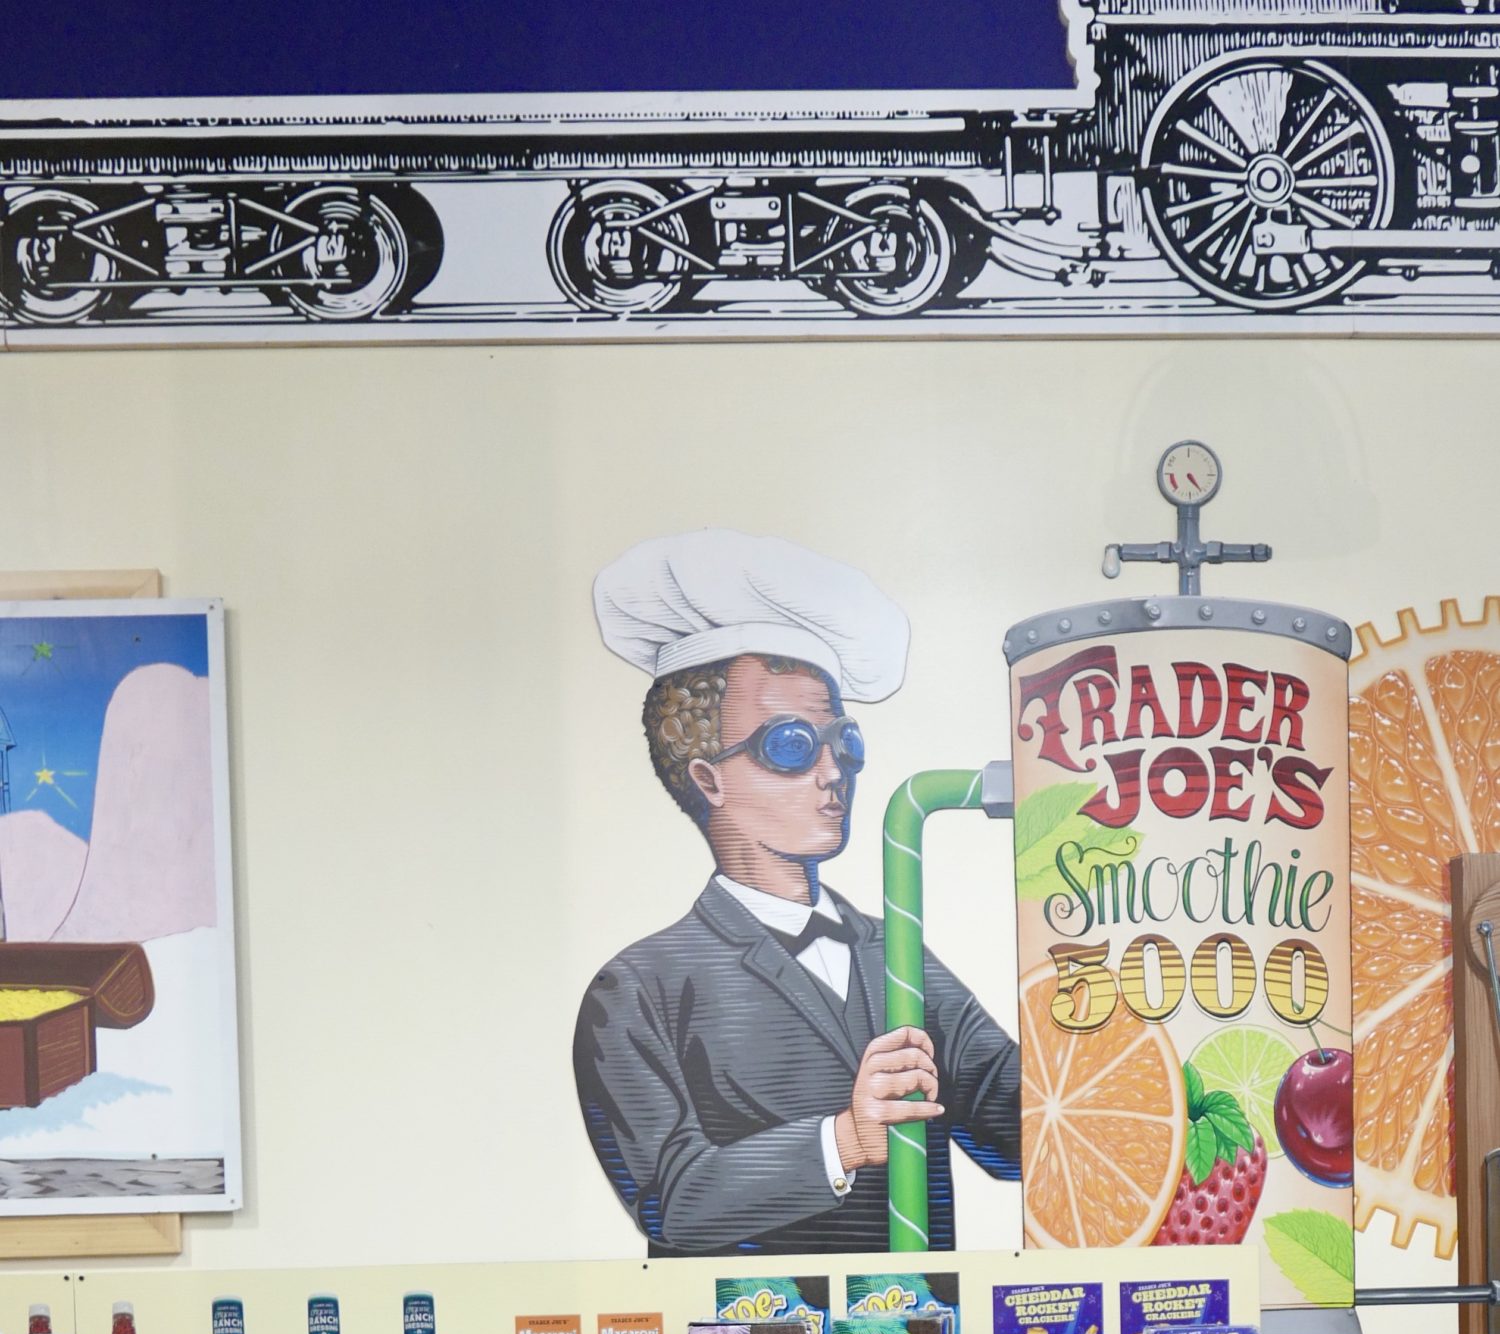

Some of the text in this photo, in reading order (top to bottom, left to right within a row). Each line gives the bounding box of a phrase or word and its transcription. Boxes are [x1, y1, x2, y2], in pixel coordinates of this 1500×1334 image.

[1018, 645, 1312, 772] TRADER
[1077, 745, 1335, 829] JOE'S
[1043, 836, 1334, 937] Smoothie
[1047, 932, 1330, 1033] 5000
[1005, 1287, 1086, 1306] CHEDDAR
[1132, 1284, 1212, 1303] CHEDDAR
[1015, 1301, 1080, 1317] ROCKET
[1142, 1297, 1206, 1313] ROCKET
[213, 1318, 243, 1328] RANCH
[309, 1315, 339, 1326] RANCH
[404, 1313, 434, 1323] RANCH
